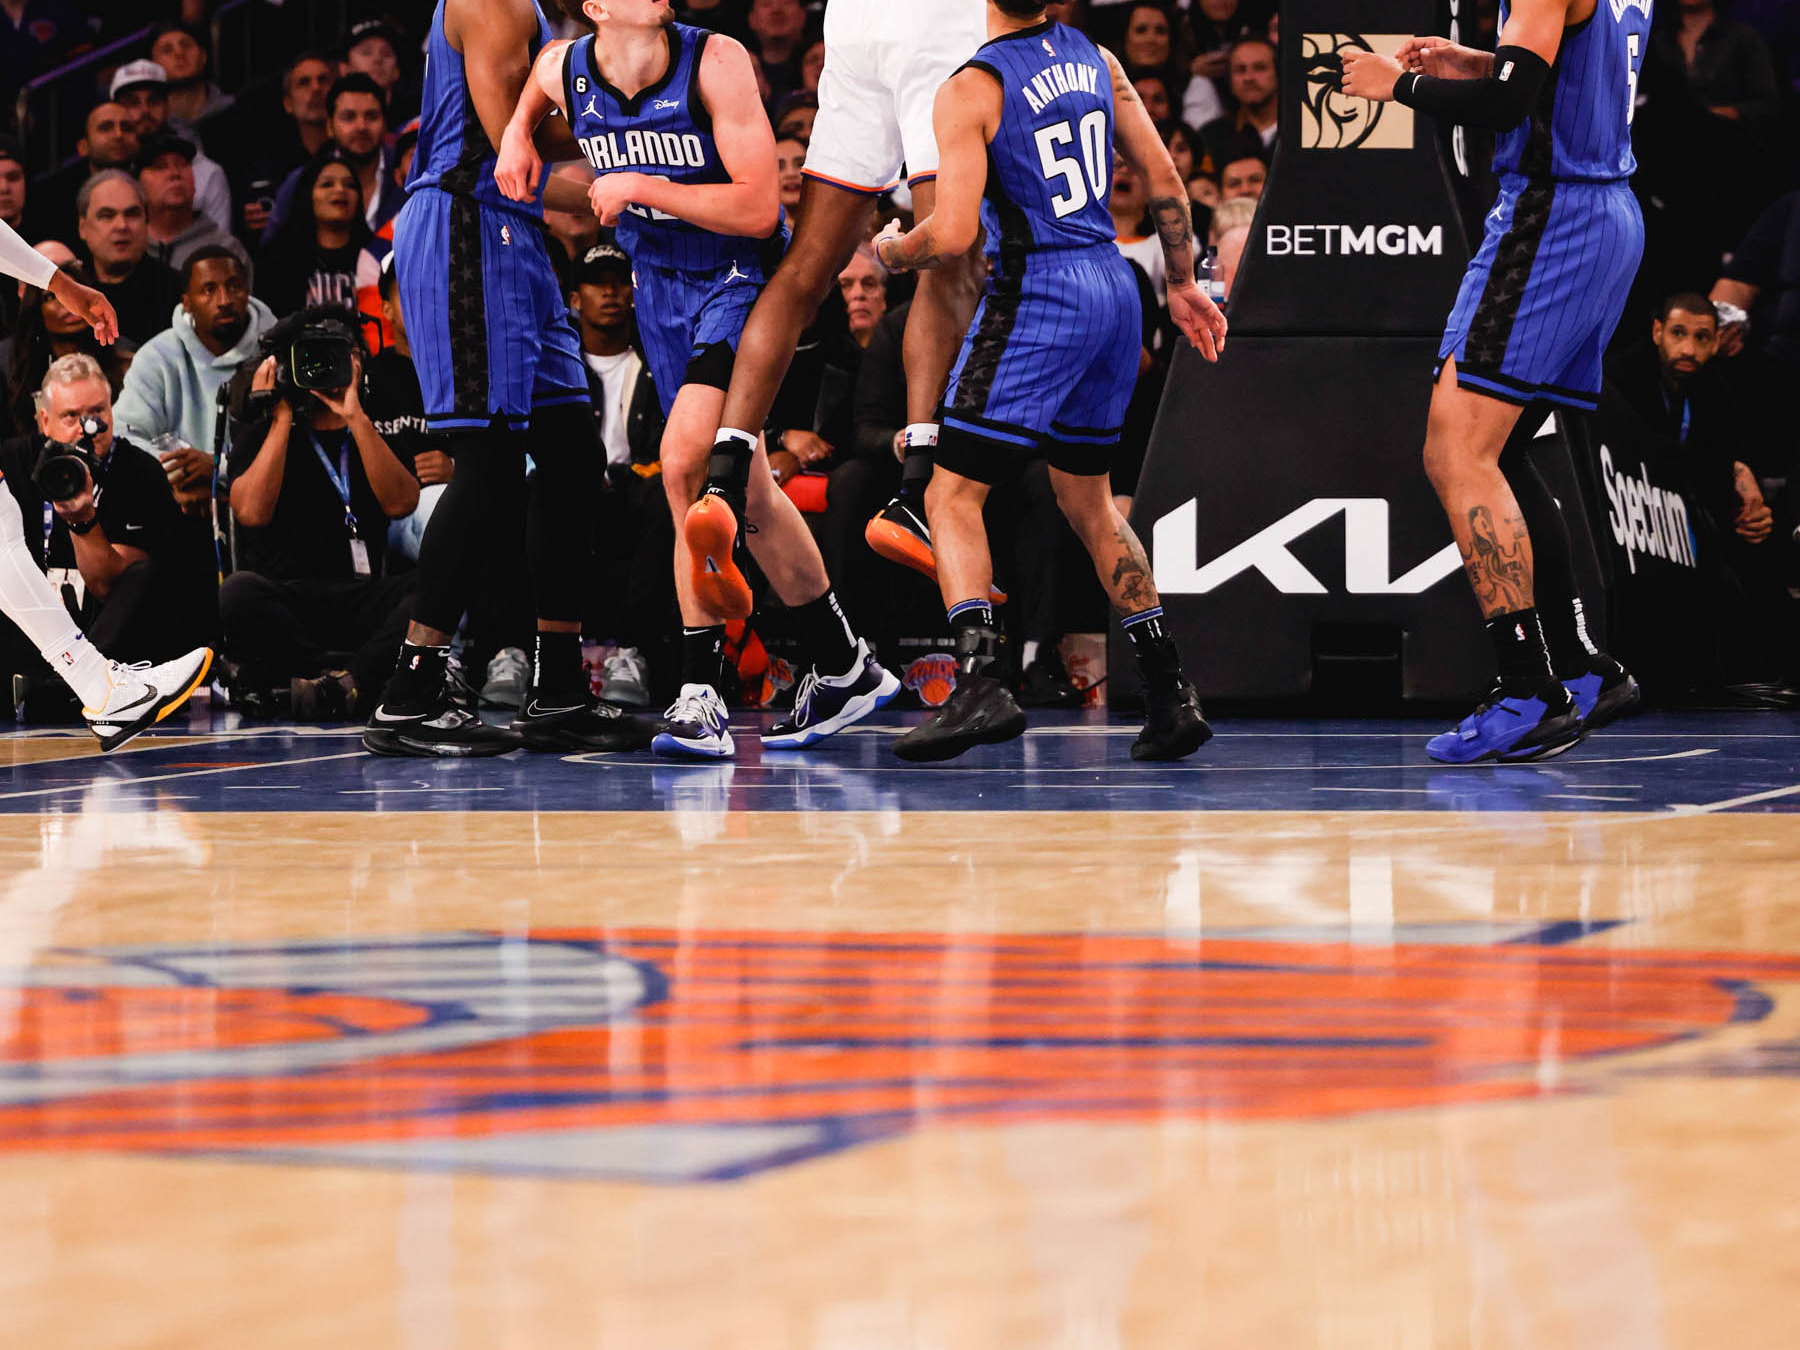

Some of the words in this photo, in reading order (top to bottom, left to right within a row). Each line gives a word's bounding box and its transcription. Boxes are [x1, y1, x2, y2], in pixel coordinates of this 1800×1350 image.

[576, 77, 587, 93] 6
[1022, 62, 1098, 115] ANTHONY
[1626, 33, 1640, 126] 5
[578, 130, 706, 170] ORLANDO
[1034, 110, 1107, 219] 50
[1266, 224, 1443, 256] BETMGM
[374, 415, 429, 434] SSENTI
[1599, 444, 1696, 575] Spectrum
